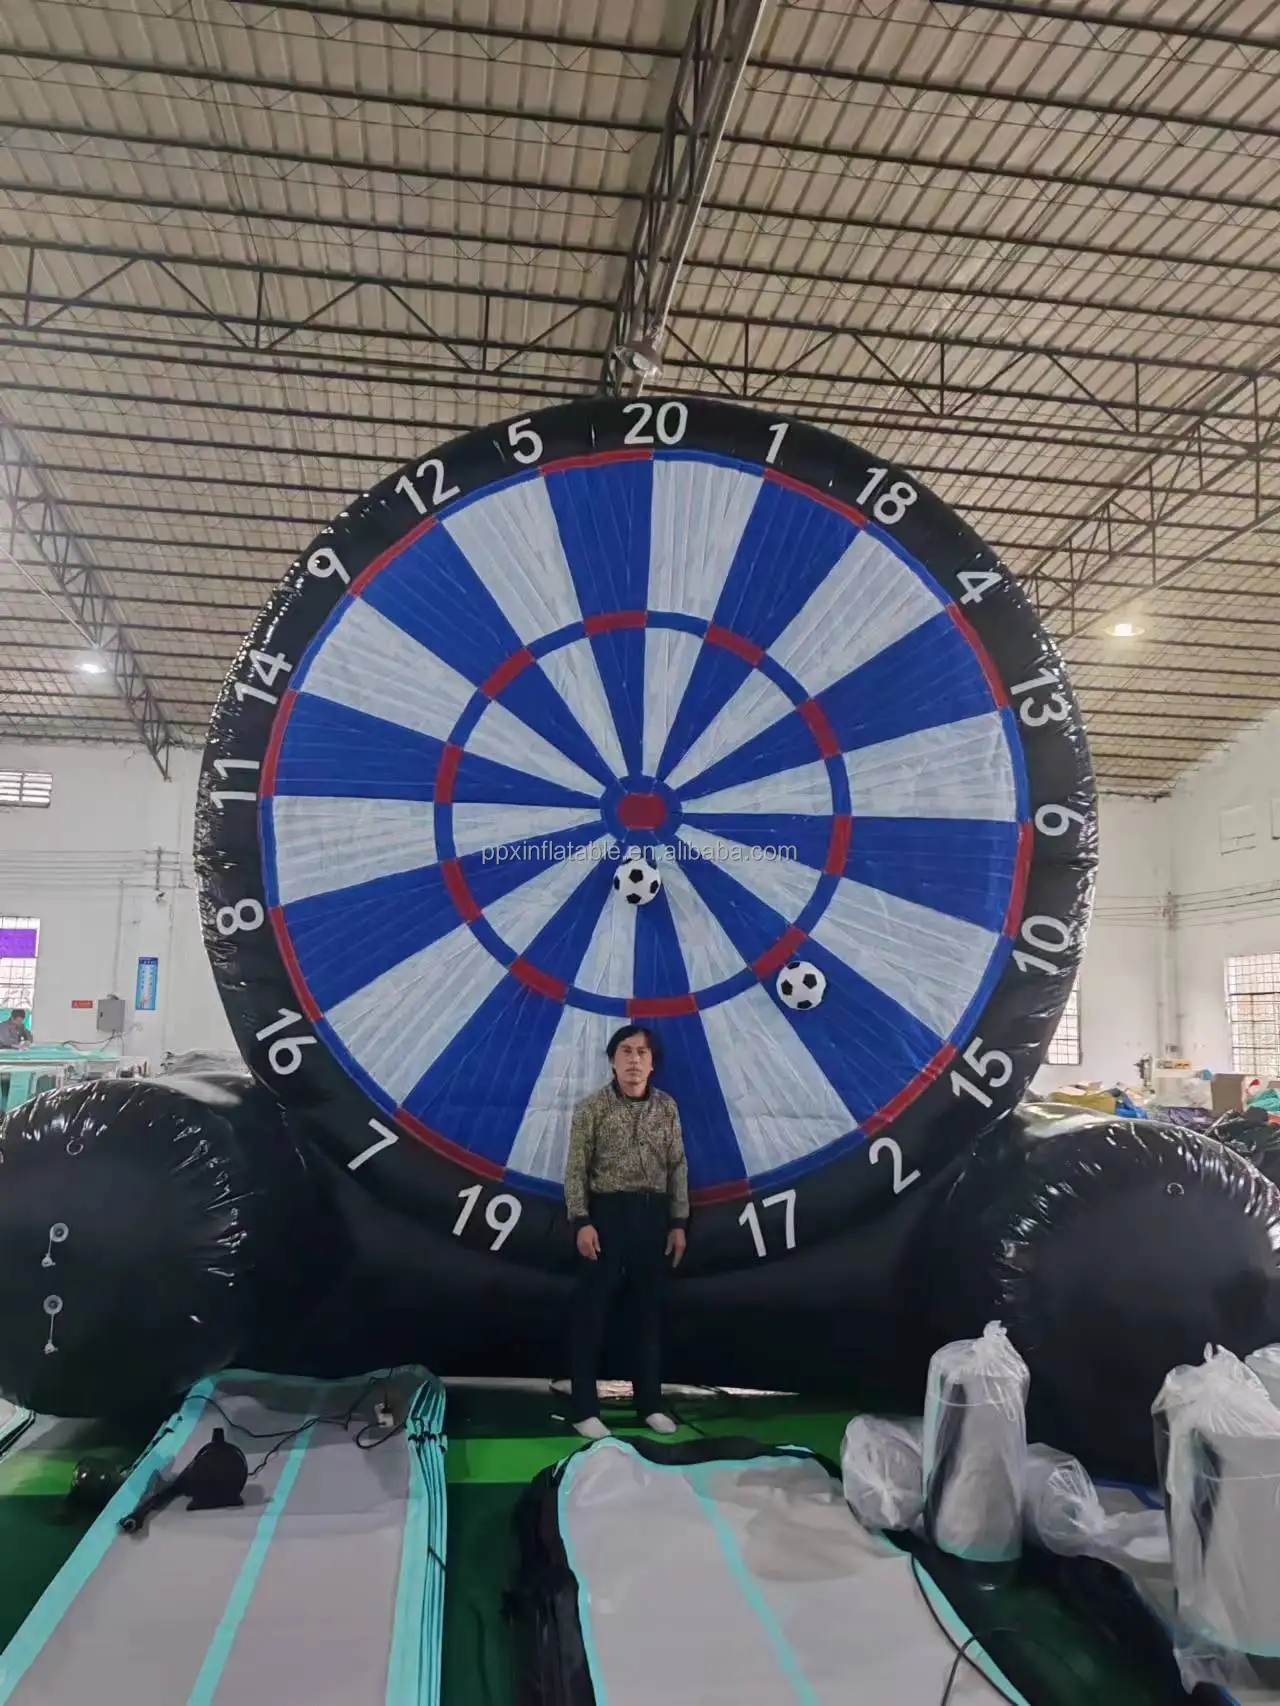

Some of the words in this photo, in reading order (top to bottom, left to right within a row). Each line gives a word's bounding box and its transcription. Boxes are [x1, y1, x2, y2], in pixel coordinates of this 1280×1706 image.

[507, 418, 543, 464] 5
[622, 402, 688, 446] 20
[764, 422, 790, 464] 1
[394, 458, 460, 514] 12
[855, 467, 918, 525] 18
[307, 547, 350, 584] 9
[956, 571, 1002, 605] 4
[234, 649, 293, 706] 14
[1010, 667, 1070, 728] 13
[210, 759, 261, 808] 11
[216, 898, 264, 936] 8
[1012, 915, 1072, 977] 10
[256, 1008, 318, 1076] 16
[949, 1037, 1013, 1109] 15
[347, 1118, 399, 1171] 7
[868, 1137, 921, 1195] 2
[452, 1184, 523, 1251] 19
[738, 1189, 797, 1257] 17
